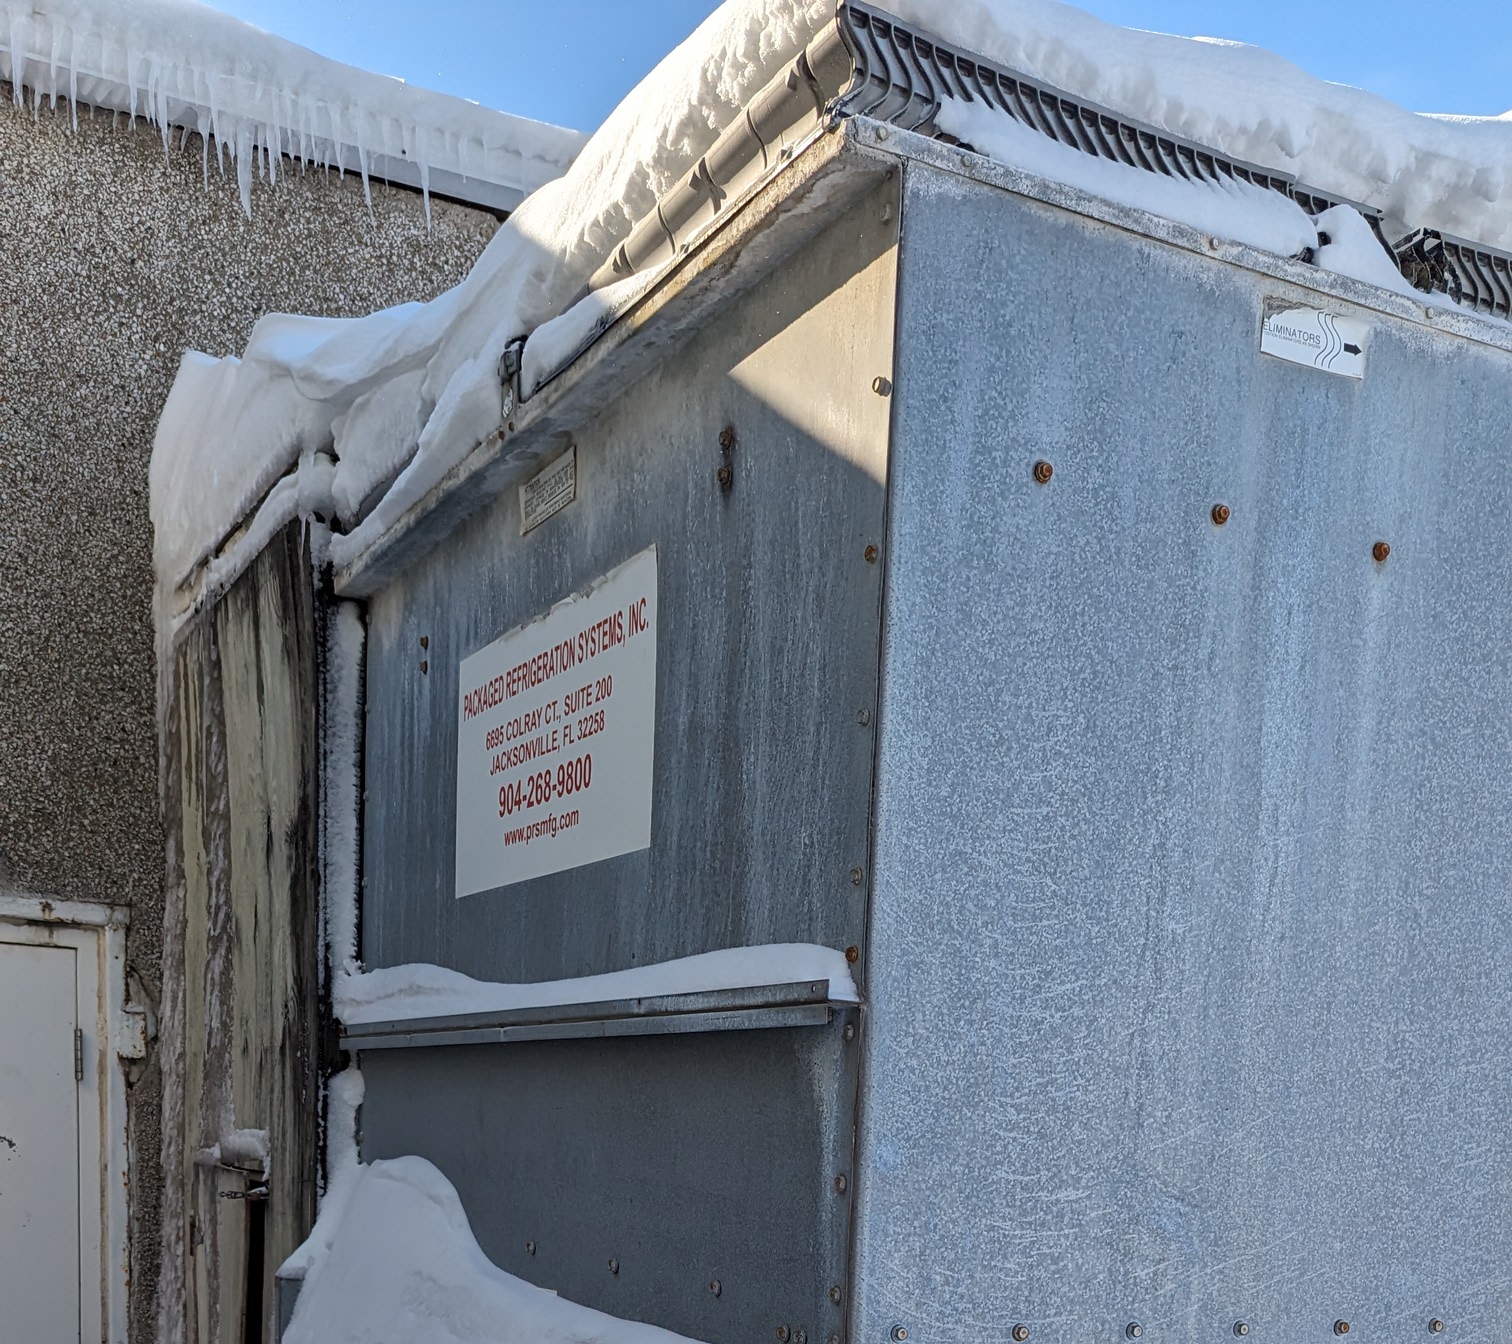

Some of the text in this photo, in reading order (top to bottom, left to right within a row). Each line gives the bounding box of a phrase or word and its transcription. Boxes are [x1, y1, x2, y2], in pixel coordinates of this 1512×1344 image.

[1264, 320, 1320, 345] ELIMINATORS
[463, 597, 649, 722] PACKAGED REFRIGERATION SYSTEMS, INC.
[485, 674, 613, 751] 6695 COLRAY CT., SUITE 200
[489, 709, 605, 776] JACKSONVILLE, FL 32258
[498, 753, 592, 818] 904-268-9800
[504, 809, 579, 846] www.prsmfg.com
